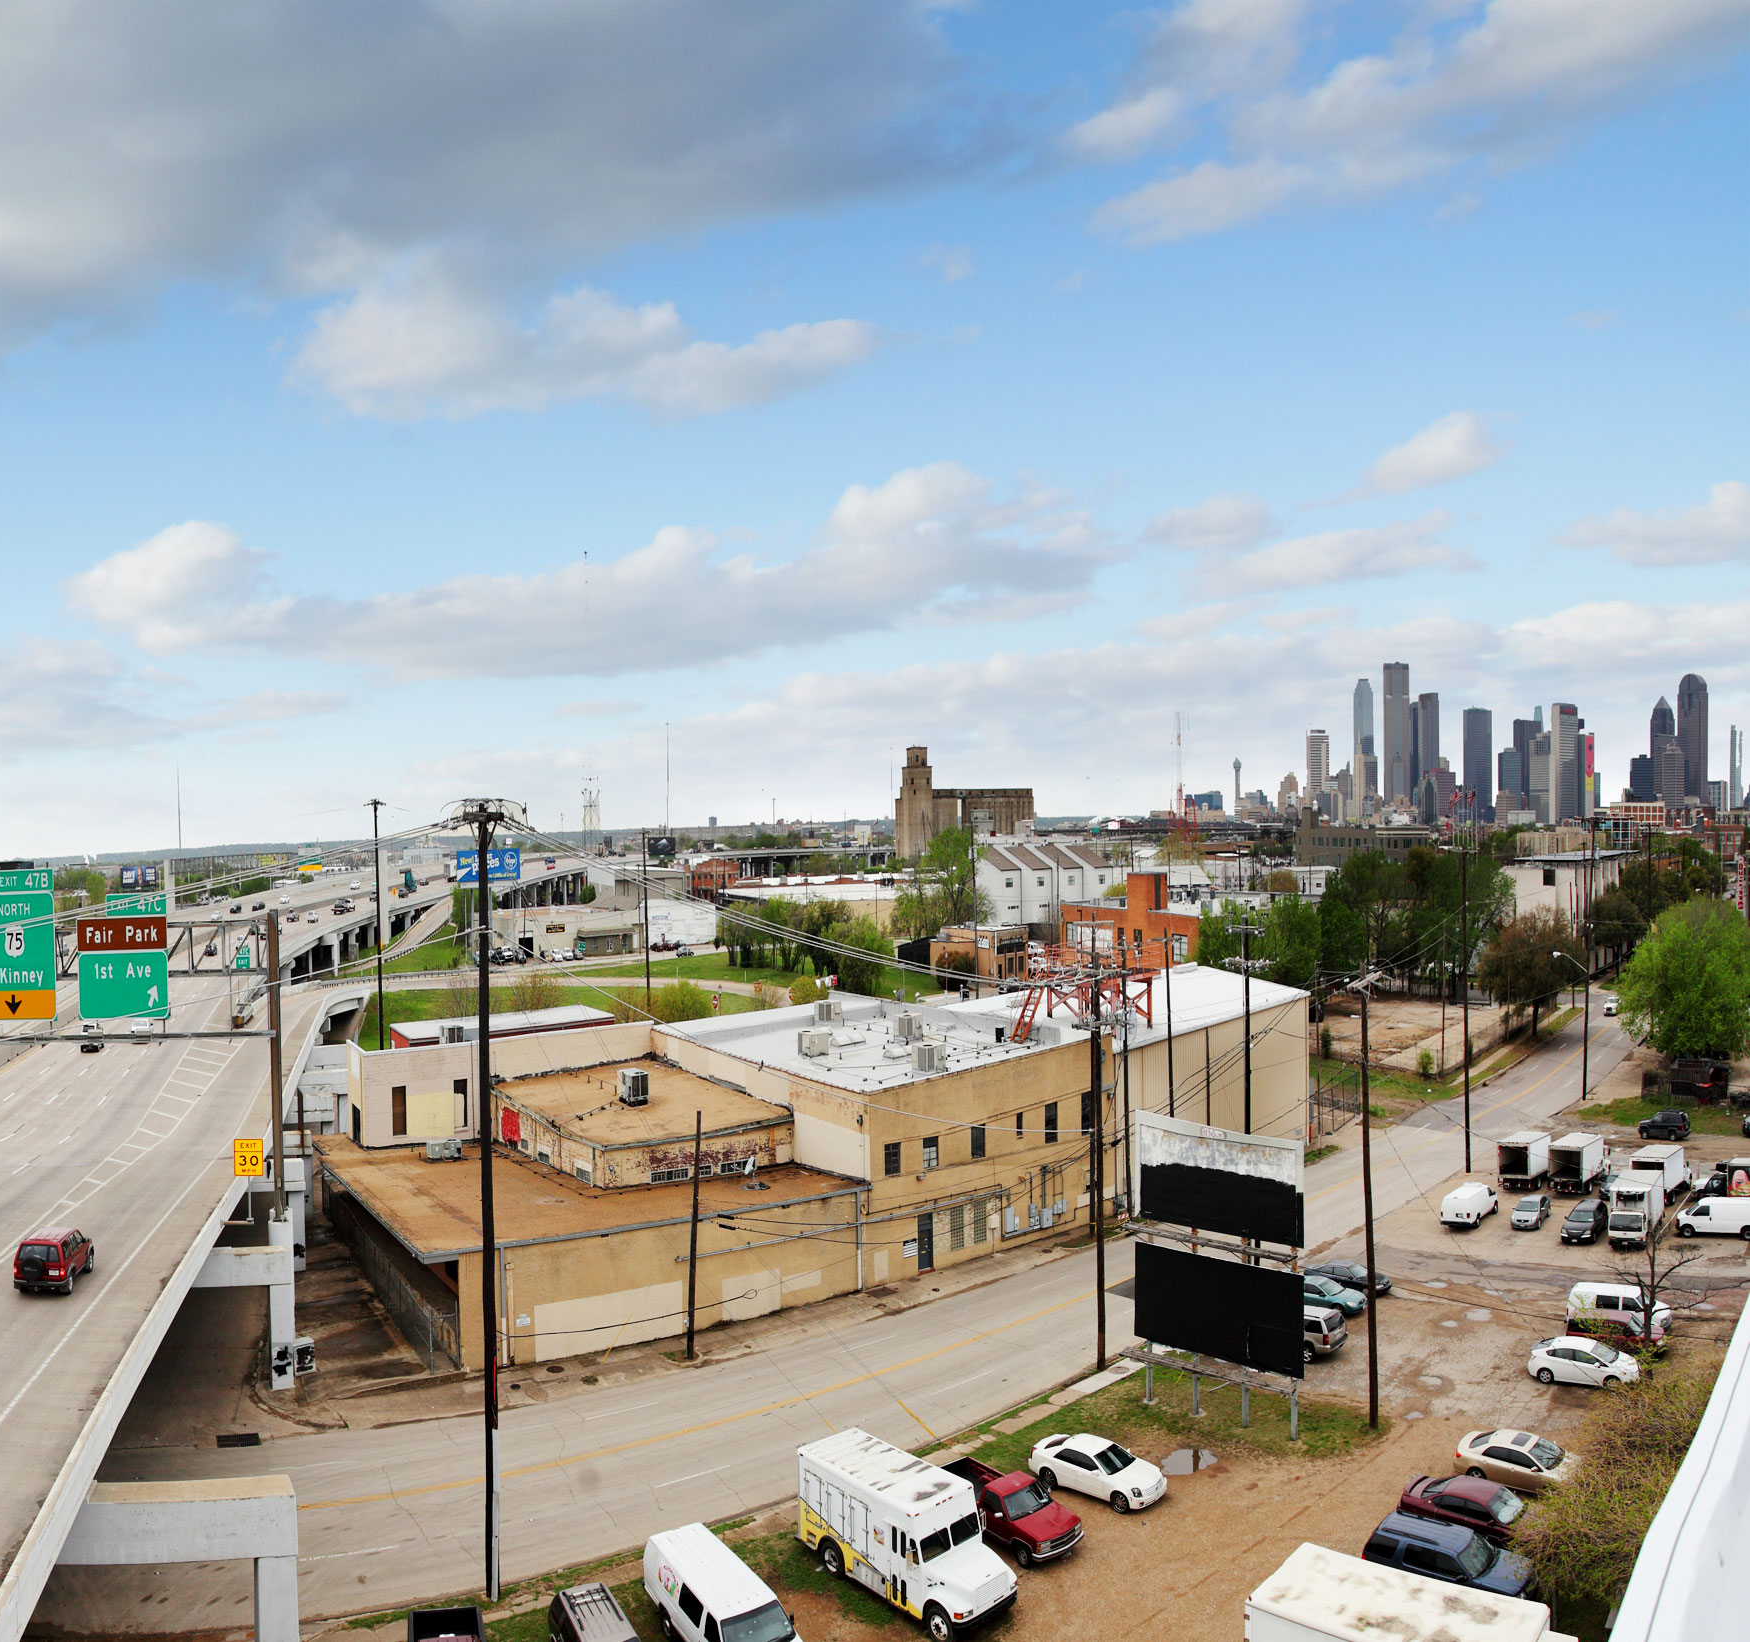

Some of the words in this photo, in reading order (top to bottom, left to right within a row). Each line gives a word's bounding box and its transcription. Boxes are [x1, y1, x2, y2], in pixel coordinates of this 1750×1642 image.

[472, 857, 499, 875] pes
[0, 876, 17, 887] EXIT
[24, 872, 49, 888] 47B
[137, 896, 162, 912] 47C
[6, 933, 23, 951] 75
[85, 926, 113, 944] Fair
[125, 925, 158, 943] Park
[94, 963, 113, 979] 1st
[126, 962, 152, 978] Ave
[239, 1155, 258, 1166] 30
